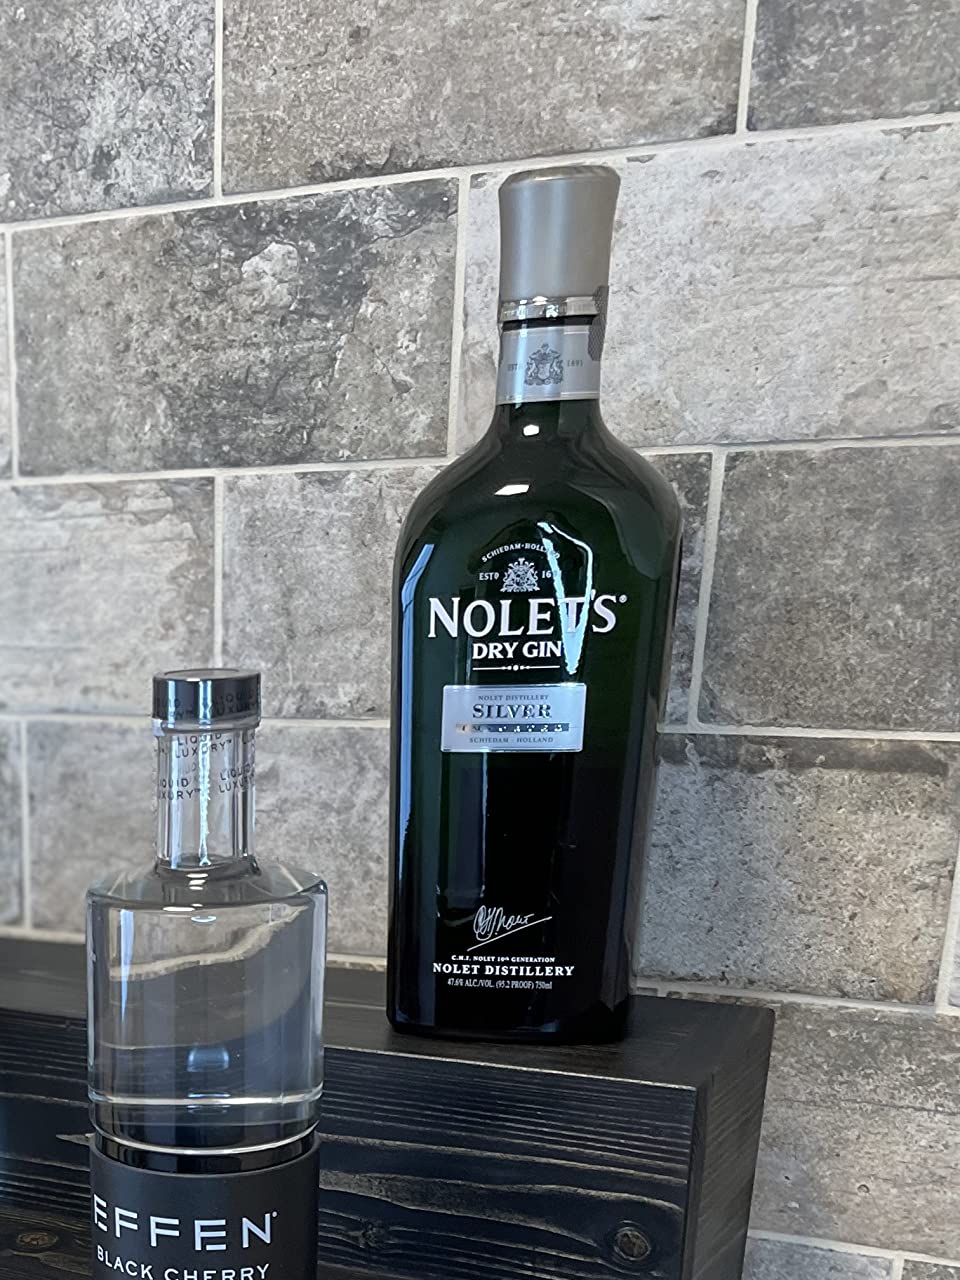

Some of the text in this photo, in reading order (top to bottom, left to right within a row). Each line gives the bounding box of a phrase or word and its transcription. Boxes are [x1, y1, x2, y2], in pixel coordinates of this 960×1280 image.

[472, 640, 562, 661] DRY GIN
[472, 704, 552, 719] SILVER
[432, 963, 575, 976] NOLET DISTILLERY
[93, 1194, 273, 1251] EFFEN
[97, 1245, 154, 1280] BLACK
